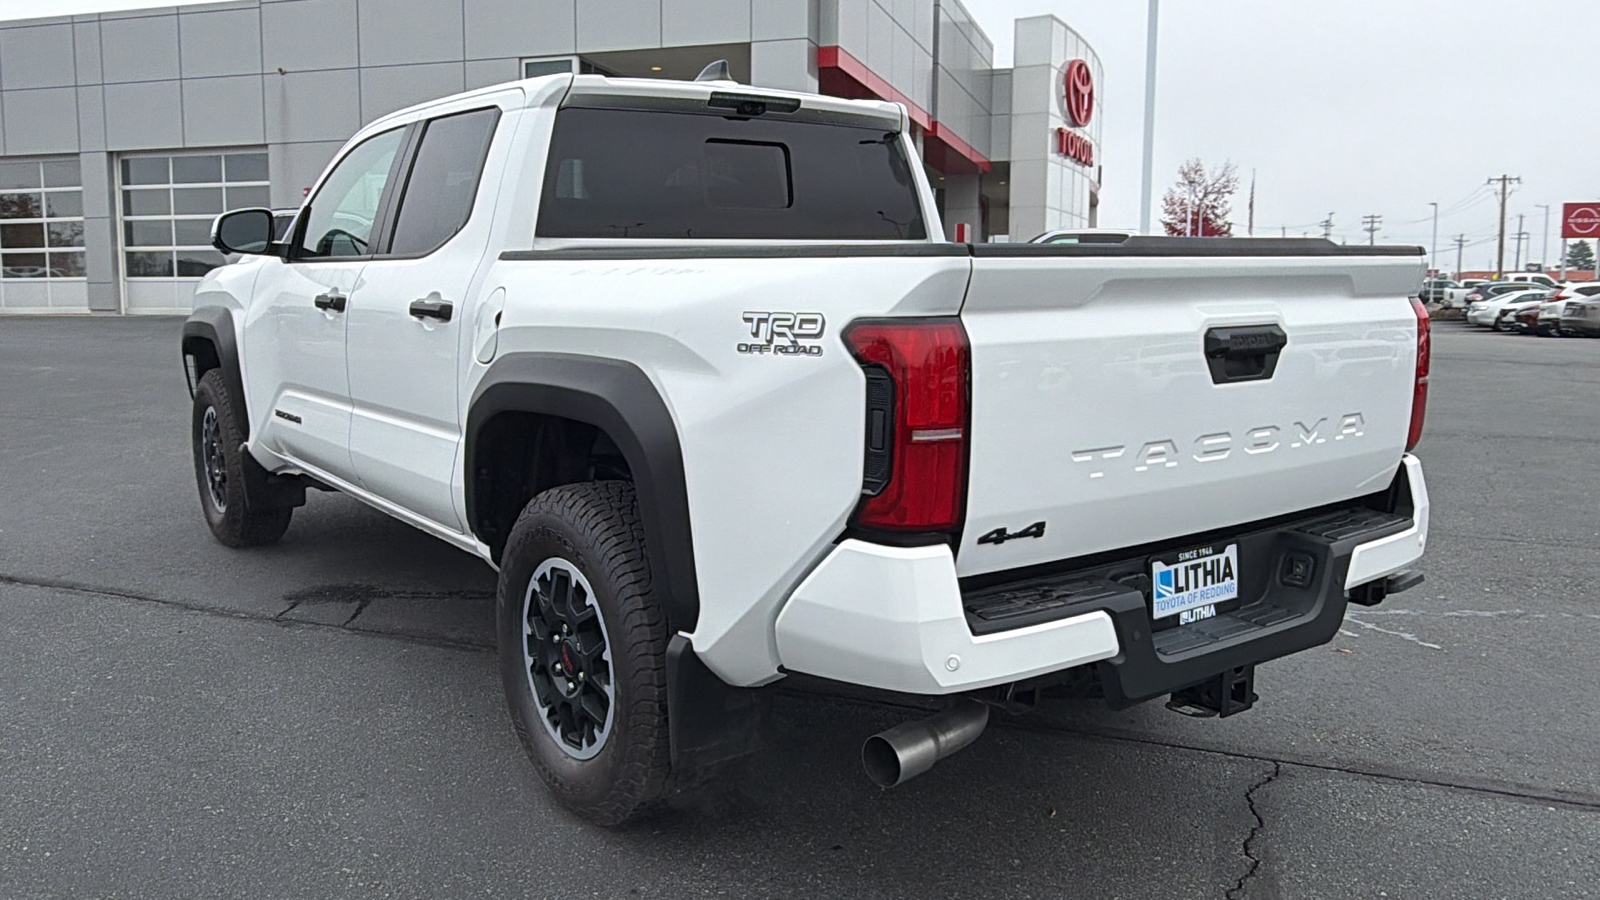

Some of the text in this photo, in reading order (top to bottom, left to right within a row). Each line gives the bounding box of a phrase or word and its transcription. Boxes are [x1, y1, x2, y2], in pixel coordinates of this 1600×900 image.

[1057, 127, 1093, 167] TOYOTA
[742, 311, 826, 344] TRD
[737, 343, 823, 357] OFF ROAD
[1071, 412, 1365, 477] TACOMA
[1179, 547, 1213, 561] SINCE 1946
[1174, 556, 1234, 594] LITHIA
[1156, 583, 1234, 612] TOYOTA OF REDDING
[1188, 604, 1216, 623] LITHIA
